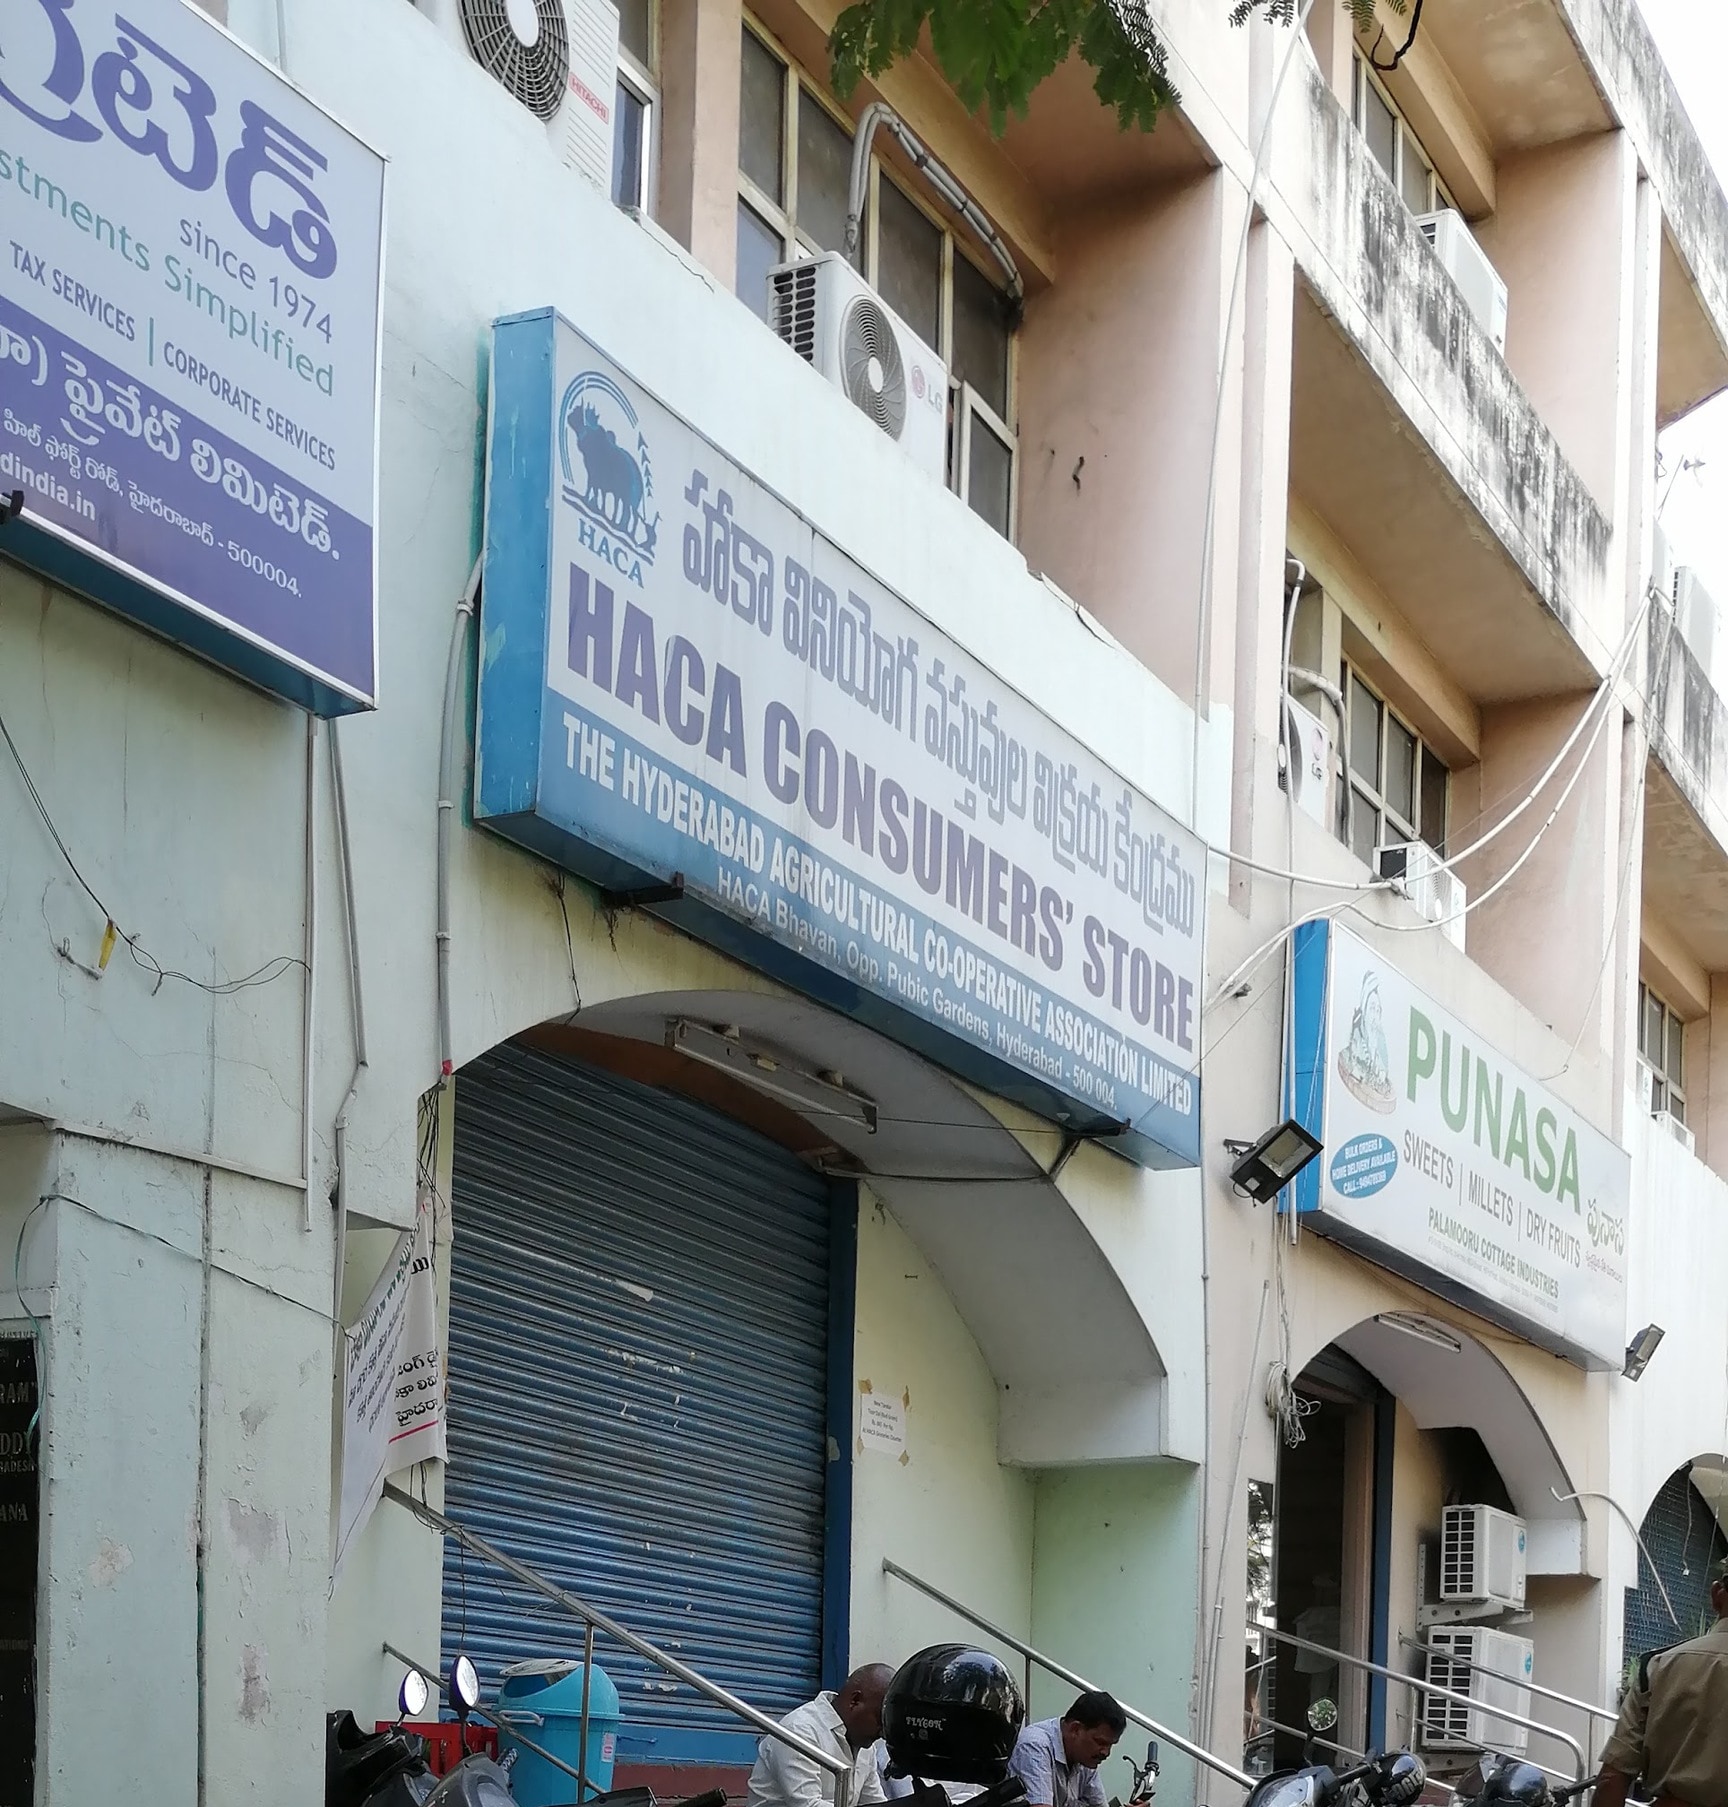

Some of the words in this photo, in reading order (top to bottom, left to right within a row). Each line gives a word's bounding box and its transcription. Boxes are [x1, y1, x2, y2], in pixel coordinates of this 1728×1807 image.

[10, 240, 46, 286] TAX
[53, 269, 135, 341] SERVICES
[164, 255, 333, 396] Simplified
[180, 219, 256, 290] since
[269, 276, 332, 343] 1974
[164, 342, 261, 423] CORPORATE
[266, 407, 335, 470] SERVICES
[228, 541, 302, 598] 500004.
[577, 518, 645, 589] HACA
[683, 469, 774, 637] హాకా
[783, 555, 919, 742] వినియోగ
[924, 658, 1028, 826] వస్తువుల
[567, 561, 747, 778] HACA
[1082, 914, 1194, 1054] STORE
[563, 711, 616, 791] THE
[622, 748, 765, 874] HYDERABAD
[769, 837, 920, 965] AGRICULTURAL
[923, 928, 1042, 1034] CO-OPERATIVE
[1045, 1001, 1138, 1089] ASSOCIATION
[1141, 1056, 1192, 1116] LIMITED
[718, 866, 771, 922] HACA
[775, 898, 842, 965] Bhavan,
[846, 940, 884, 982] Opp.
[932, 987, 993, 1047] Gardens,
[997, 1024, 1063, 1081] Hyderabad
[1073, 1065, 1094, 1098] 500
[1406, 1005, 1581, 1216] PUNASA
[1403, 1129, 1454, 1189] SWEETS
[1468, 1170, 1513, 1227] MILLETS
[1526, 1207, 1547, 1247] DRY
[1548, 1222, 1581, 1269] FRUITS
[1428, 1206, 1479, 1254] PALAMOORU
[1481, 1238, 1516, 1275] COTTAGE
[1517, 1257, 1559, 1299] INDUSTRIES
